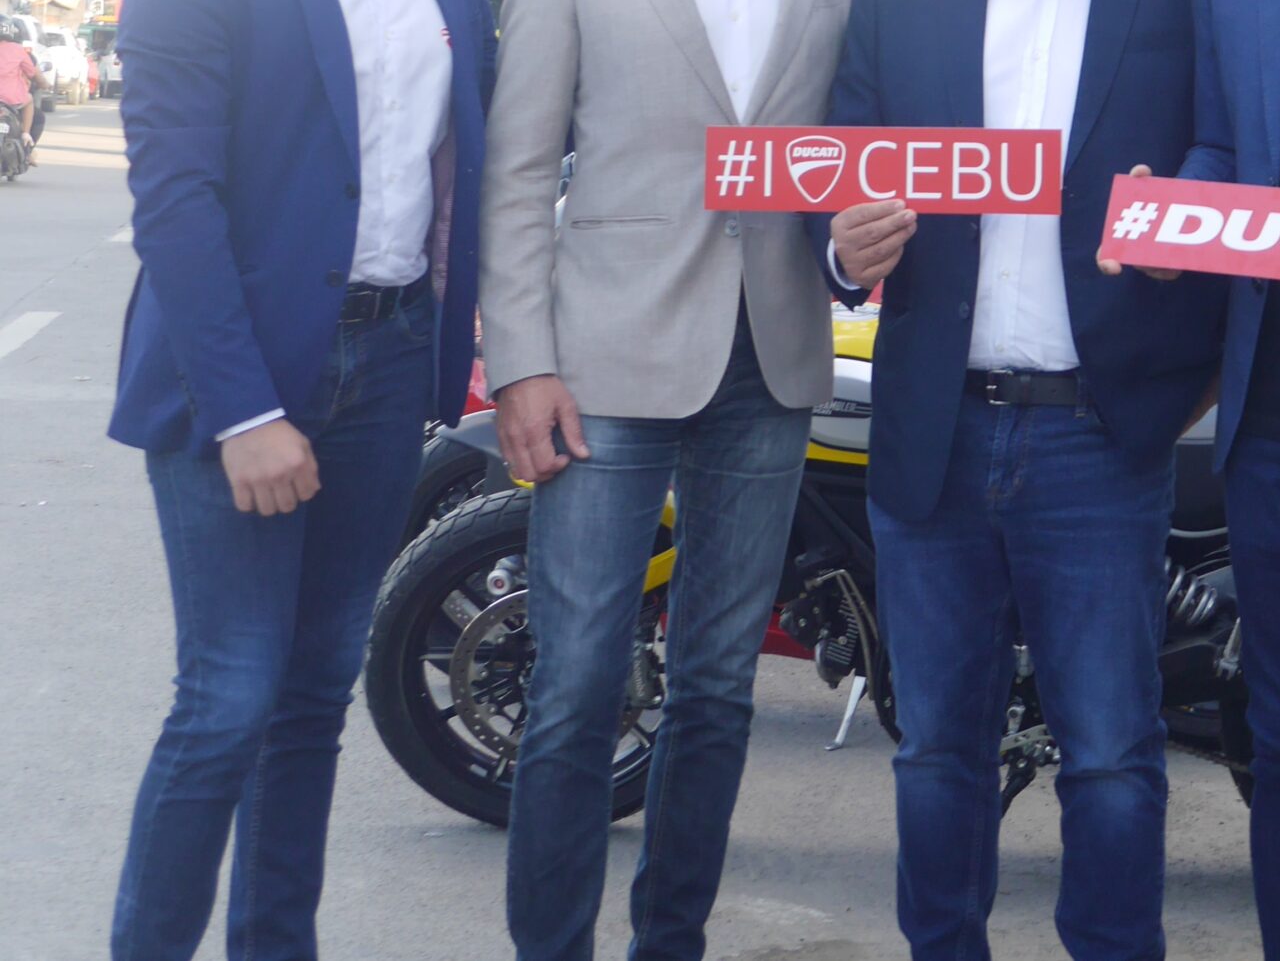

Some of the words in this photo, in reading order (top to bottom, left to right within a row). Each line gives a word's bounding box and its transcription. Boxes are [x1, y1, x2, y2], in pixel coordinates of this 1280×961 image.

[715, 140, 773, 197] #I
[792, 146, 840, 158] DUCATI
[858, 140, 1043, 202] CEBU
